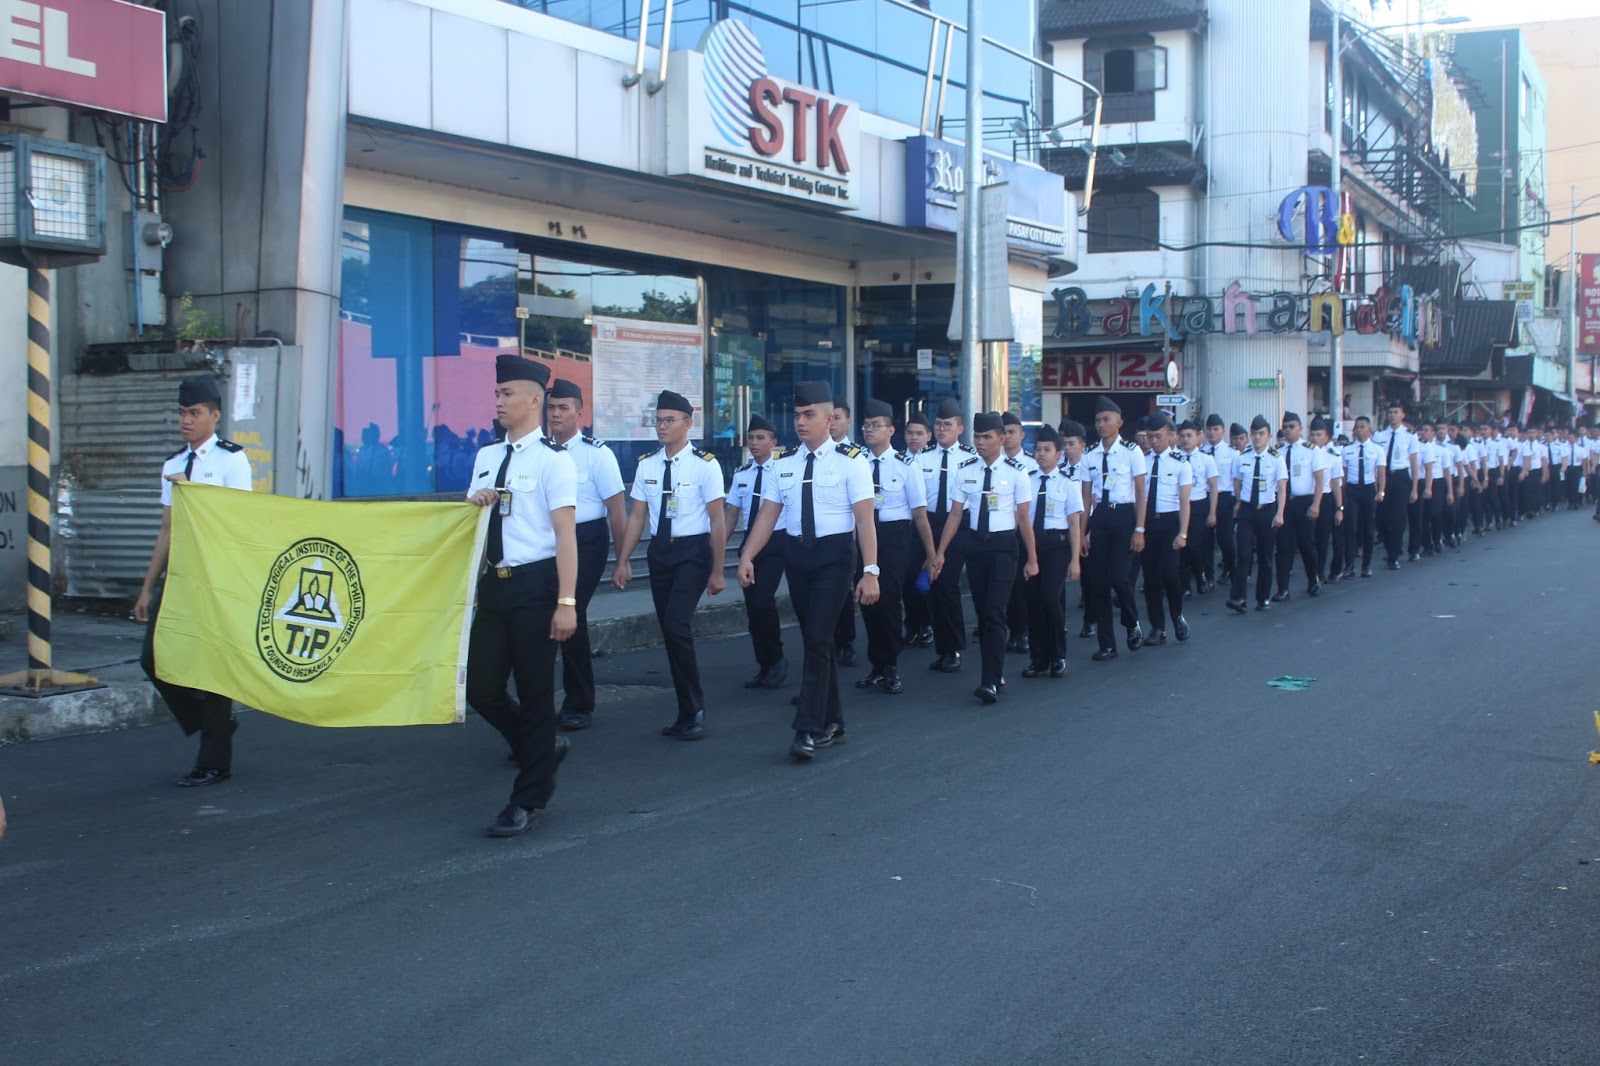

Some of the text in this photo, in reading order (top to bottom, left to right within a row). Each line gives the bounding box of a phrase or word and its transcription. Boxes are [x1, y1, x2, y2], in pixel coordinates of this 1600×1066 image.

[748, 77, 850, 174] STK
[705, 154, 737, 174] Maritime
[739, 164, 752, 178] and
[755, 166, 786, 186] Technical
[788, 174, 813, 195] Training
[815, 181, 836, 196] Center
[1009, 222, 1028, 239] PASAY
[1029, 227, 1043, 242] CITY
[1051, 280, 1346, 341] Bakahan
[1119, 380, 1179, 389] HOUR
[261, 542, 362, 645] TECHNOLOGICAL INSTITUTE OF THE PHILIPPINES
[264, 645, 333, 678] FOUNDED 1962 MANILA
